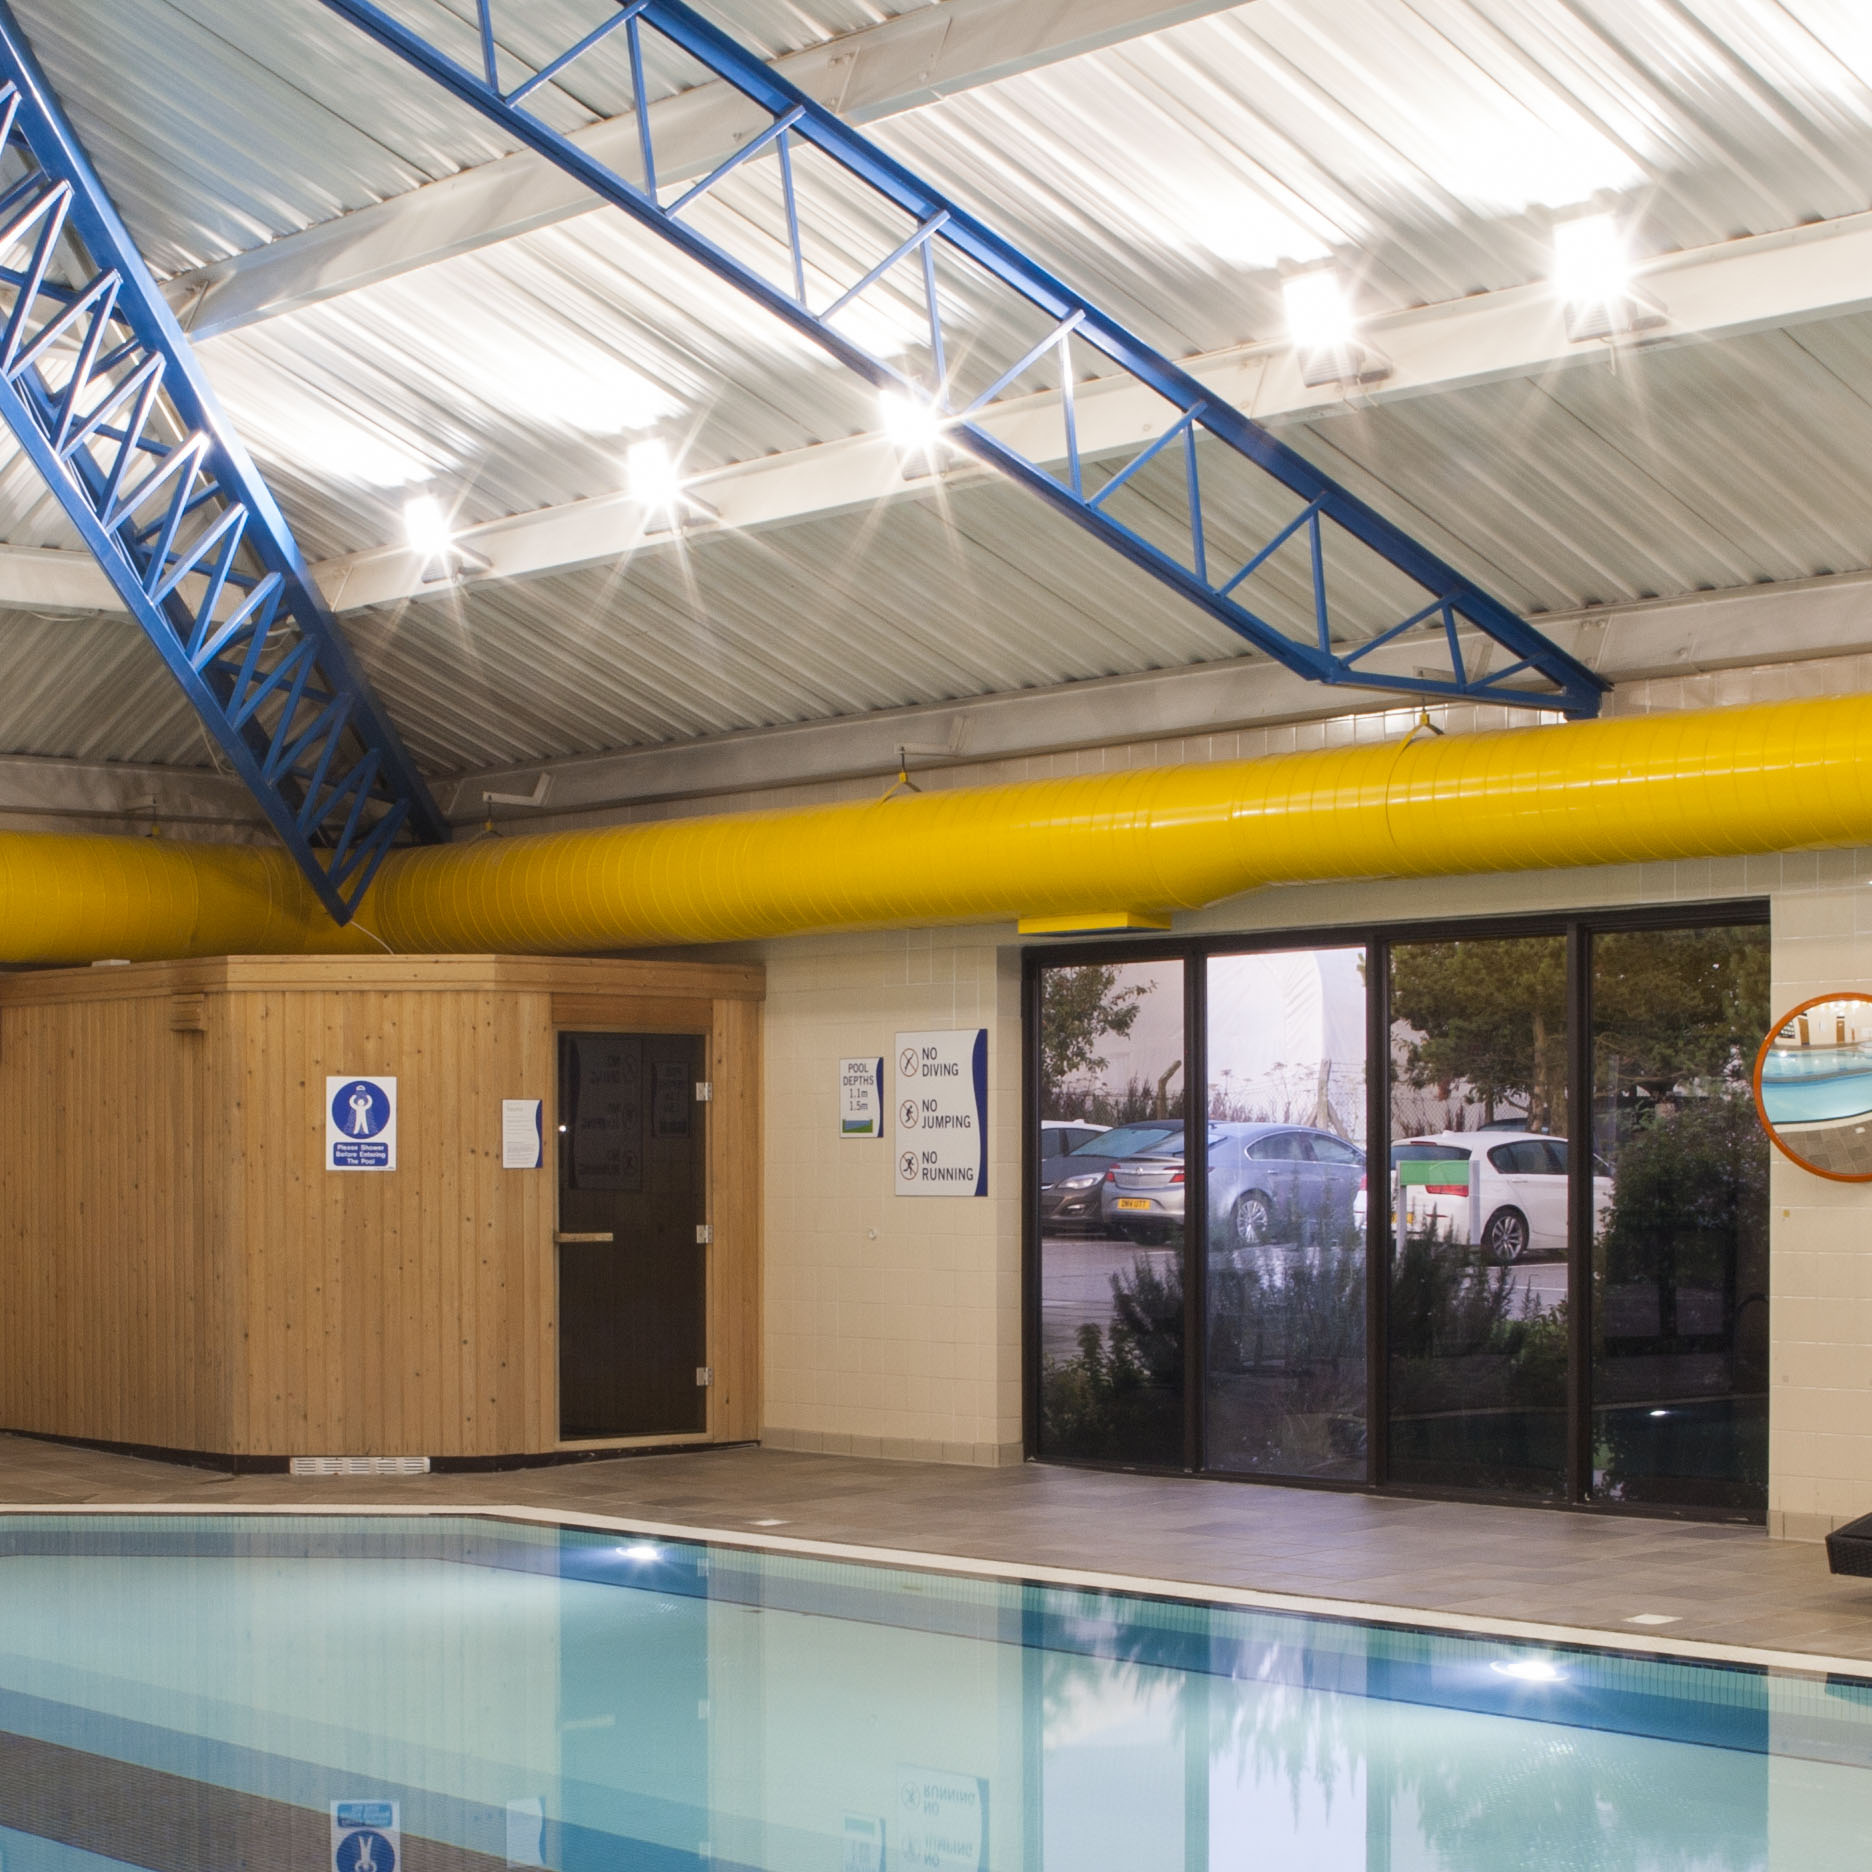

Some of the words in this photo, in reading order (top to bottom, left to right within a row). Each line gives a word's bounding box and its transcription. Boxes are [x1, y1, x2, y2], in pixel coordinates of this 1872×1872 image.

[922, 1047, 938, 1060] NO
[848, 1063, 869, 1074] POOL
[922, 1063, 959, 1077] DIVING
[842, 1075, 875, 1086] DEPTHS
[849, 1088, 868, 1099] 1.1m
[849, 1101, 868, 1111] 1.5m
[922, 1099, 938, 1112] NO
[921, 1115, 971, 1129] JUMPING
[922, 1151, 938, 1164] NO
[922, 1168, 974, 1181] RUNNING
